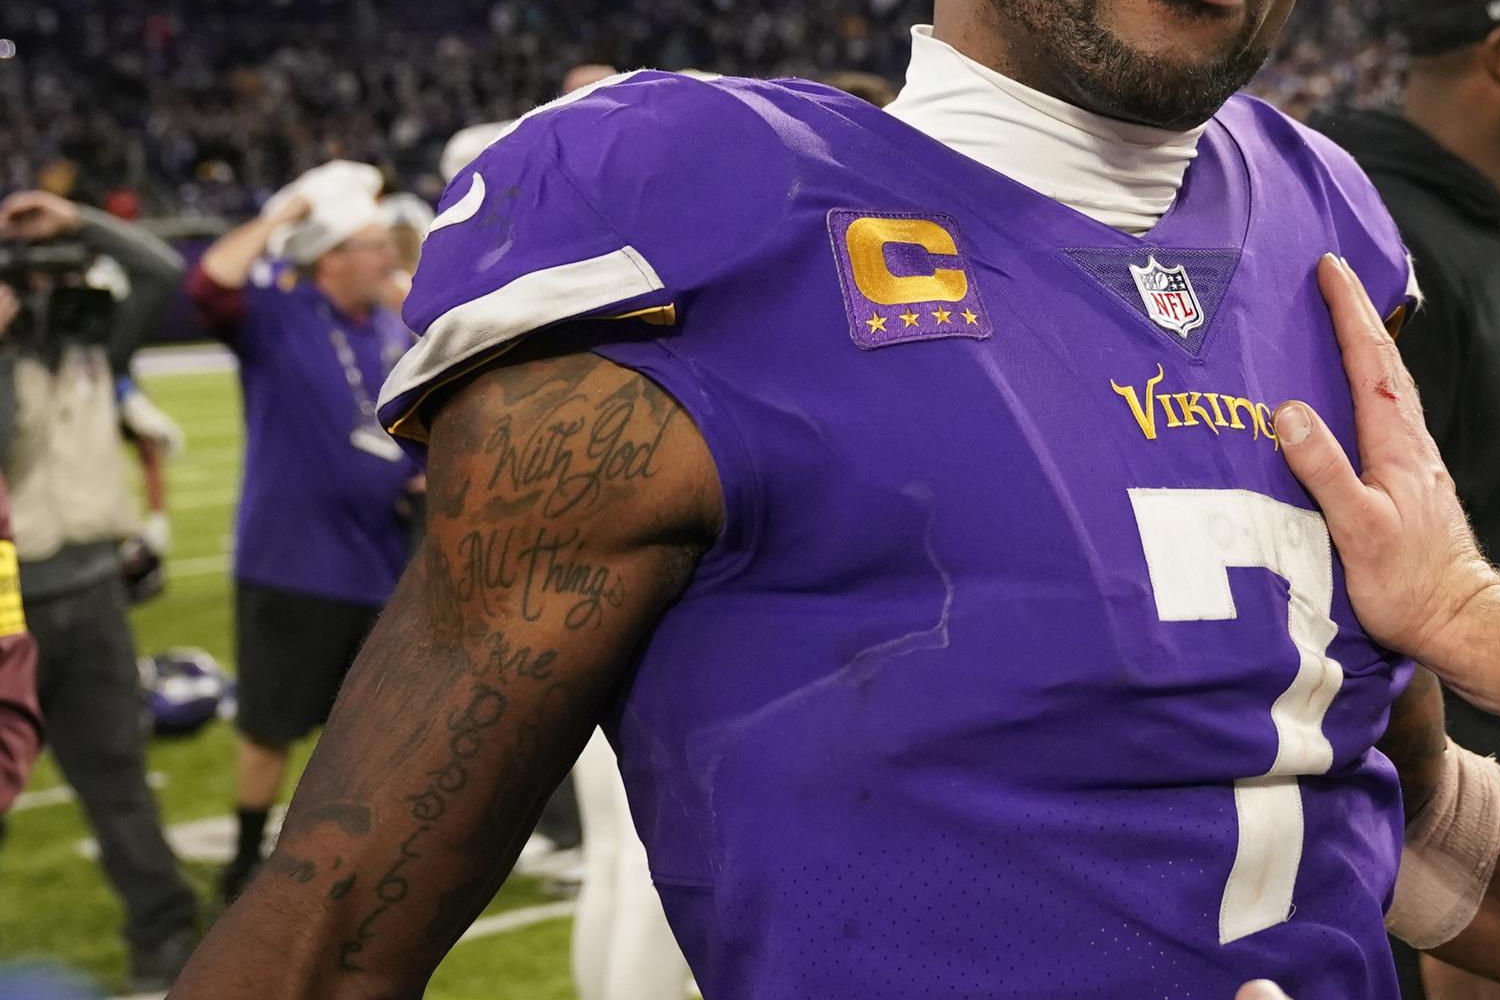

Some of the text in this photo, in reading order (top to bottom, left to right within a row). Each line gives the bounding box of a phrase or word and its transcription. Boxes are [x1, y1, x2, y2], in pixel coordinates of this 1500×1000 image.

[846, 217, 968, 305] C
[1151, 292, 1194, 321] NFL
[1111, 363, 1279, 451] VIKING
[1127, 487, 1343, 945] 7
